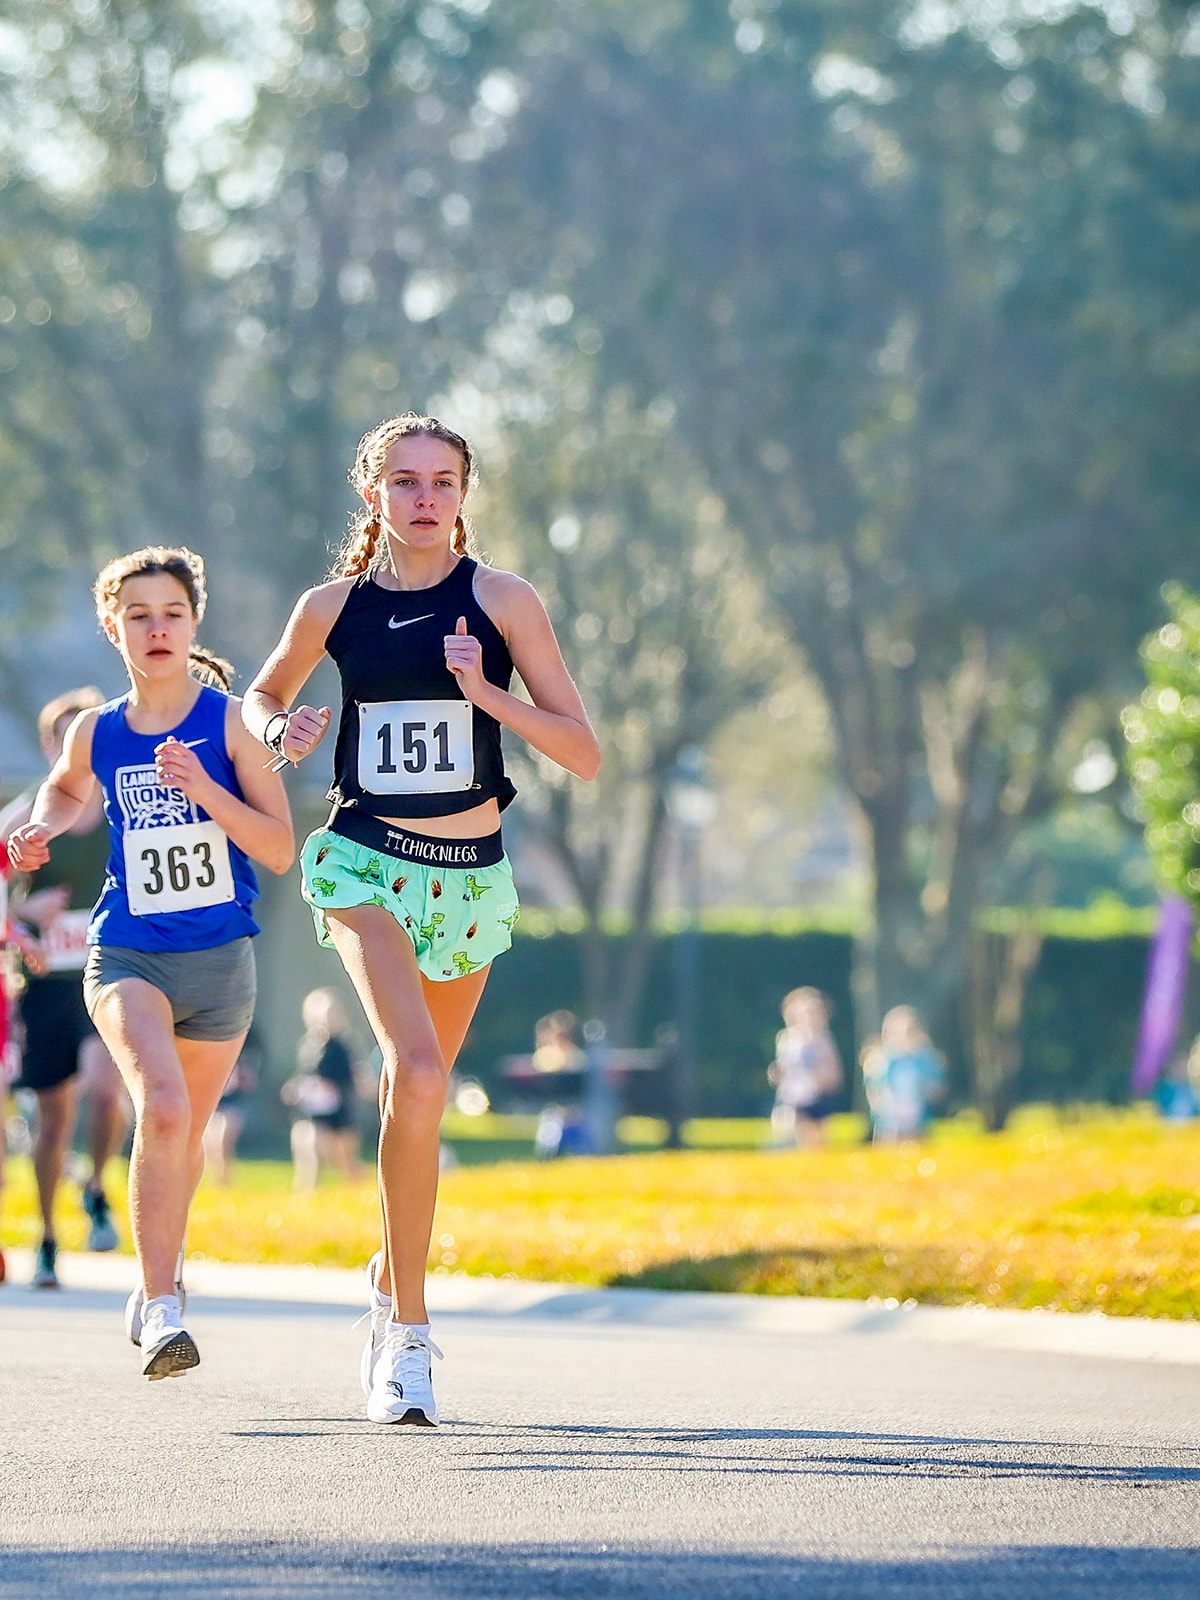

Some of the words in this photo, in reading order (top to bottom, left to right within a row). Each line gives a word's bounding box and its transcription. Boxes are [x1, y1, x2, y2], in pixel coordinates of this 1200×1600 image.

[376, 721, 455, 774] 151
[125, 787, 185, 813] LIONS
[141, 842, 216, 895] 363
[401, 837, 478, 863] CHICKNLEGS
